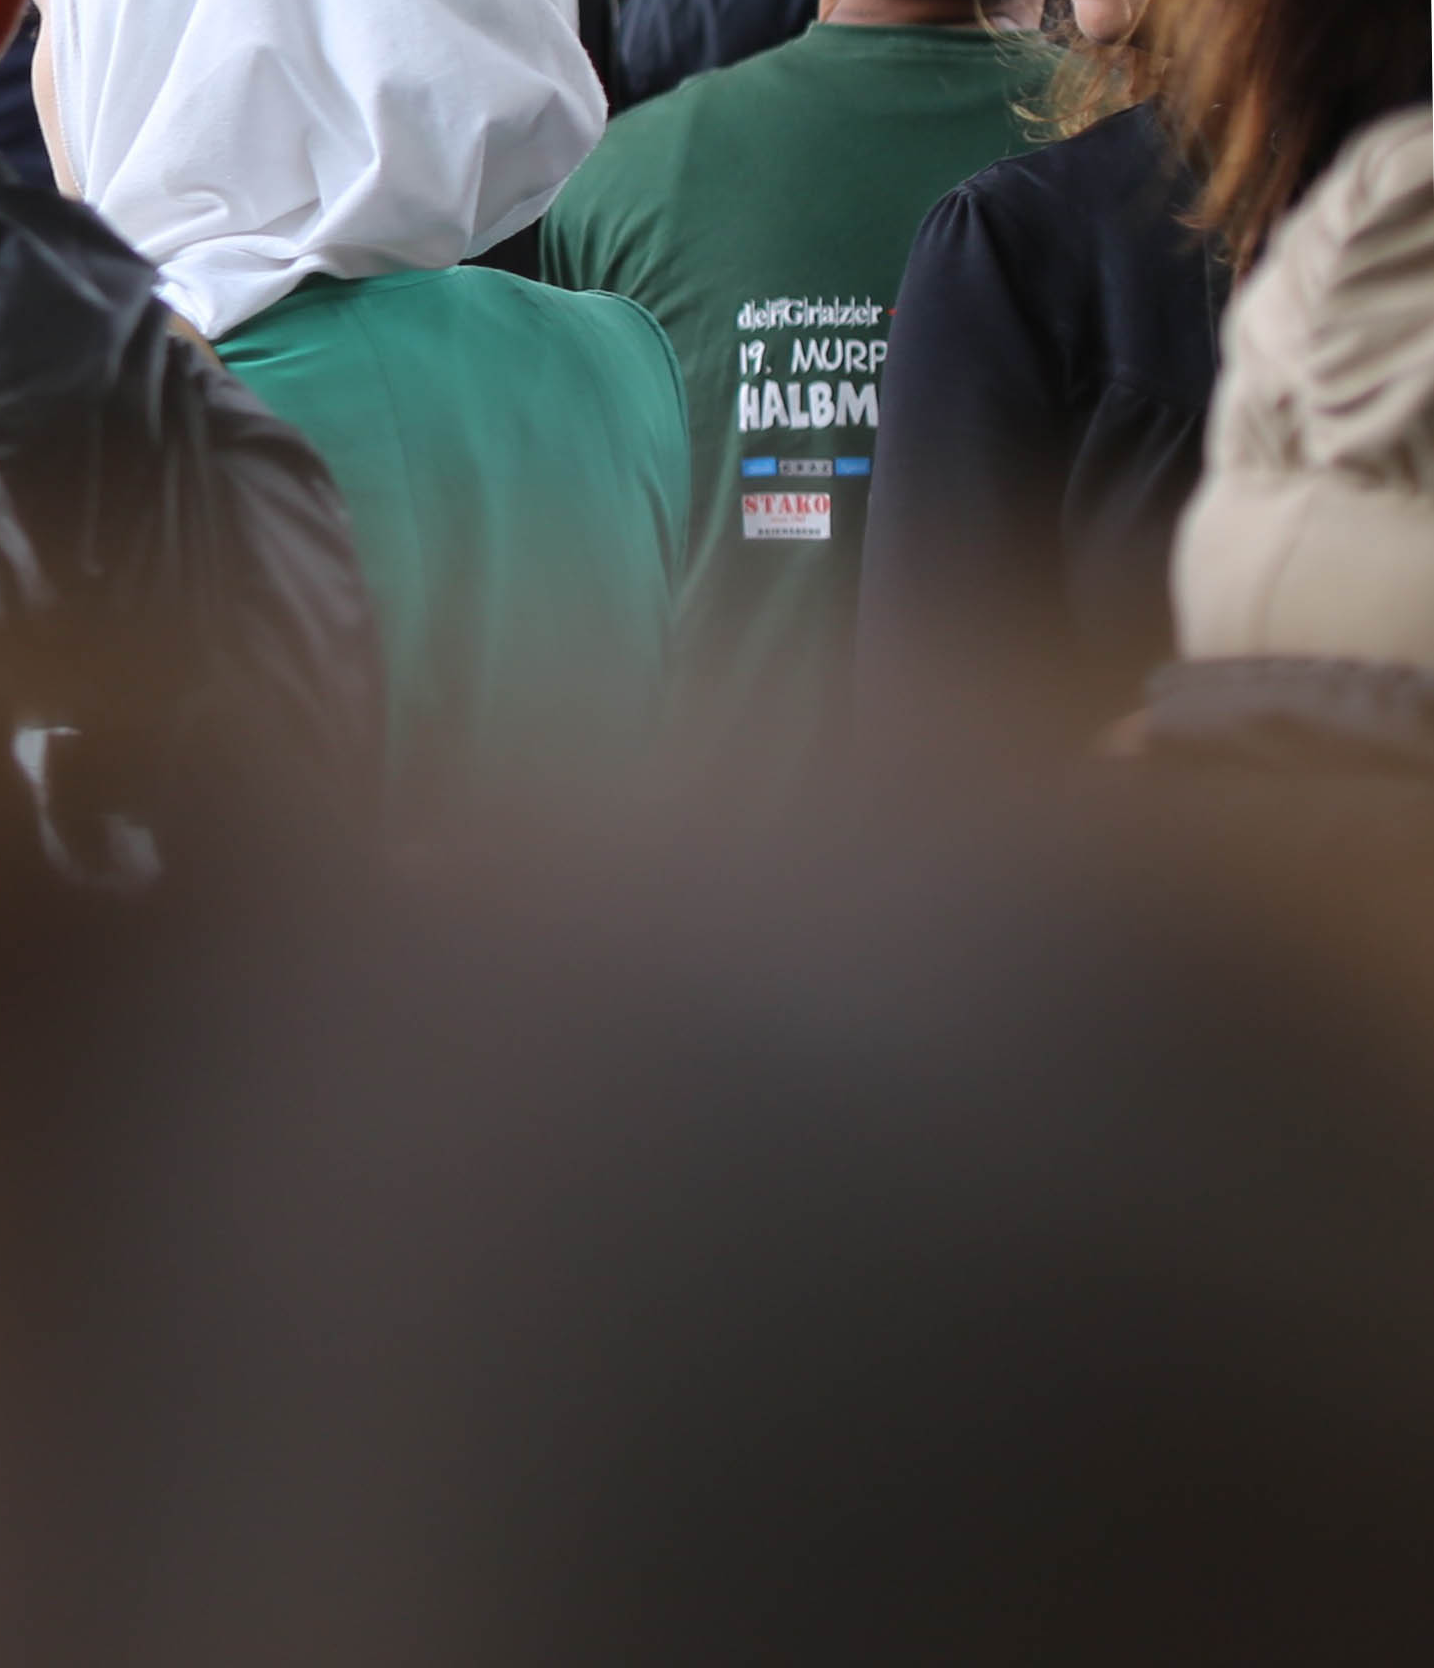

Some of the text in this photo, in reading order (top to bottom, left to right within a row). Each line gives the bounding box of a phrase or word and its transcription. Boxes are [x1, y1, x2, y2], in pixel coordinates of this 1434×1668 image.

[739, 337, 888, 375] 19. MURP
[739, 380, 880, 432] HALBM
